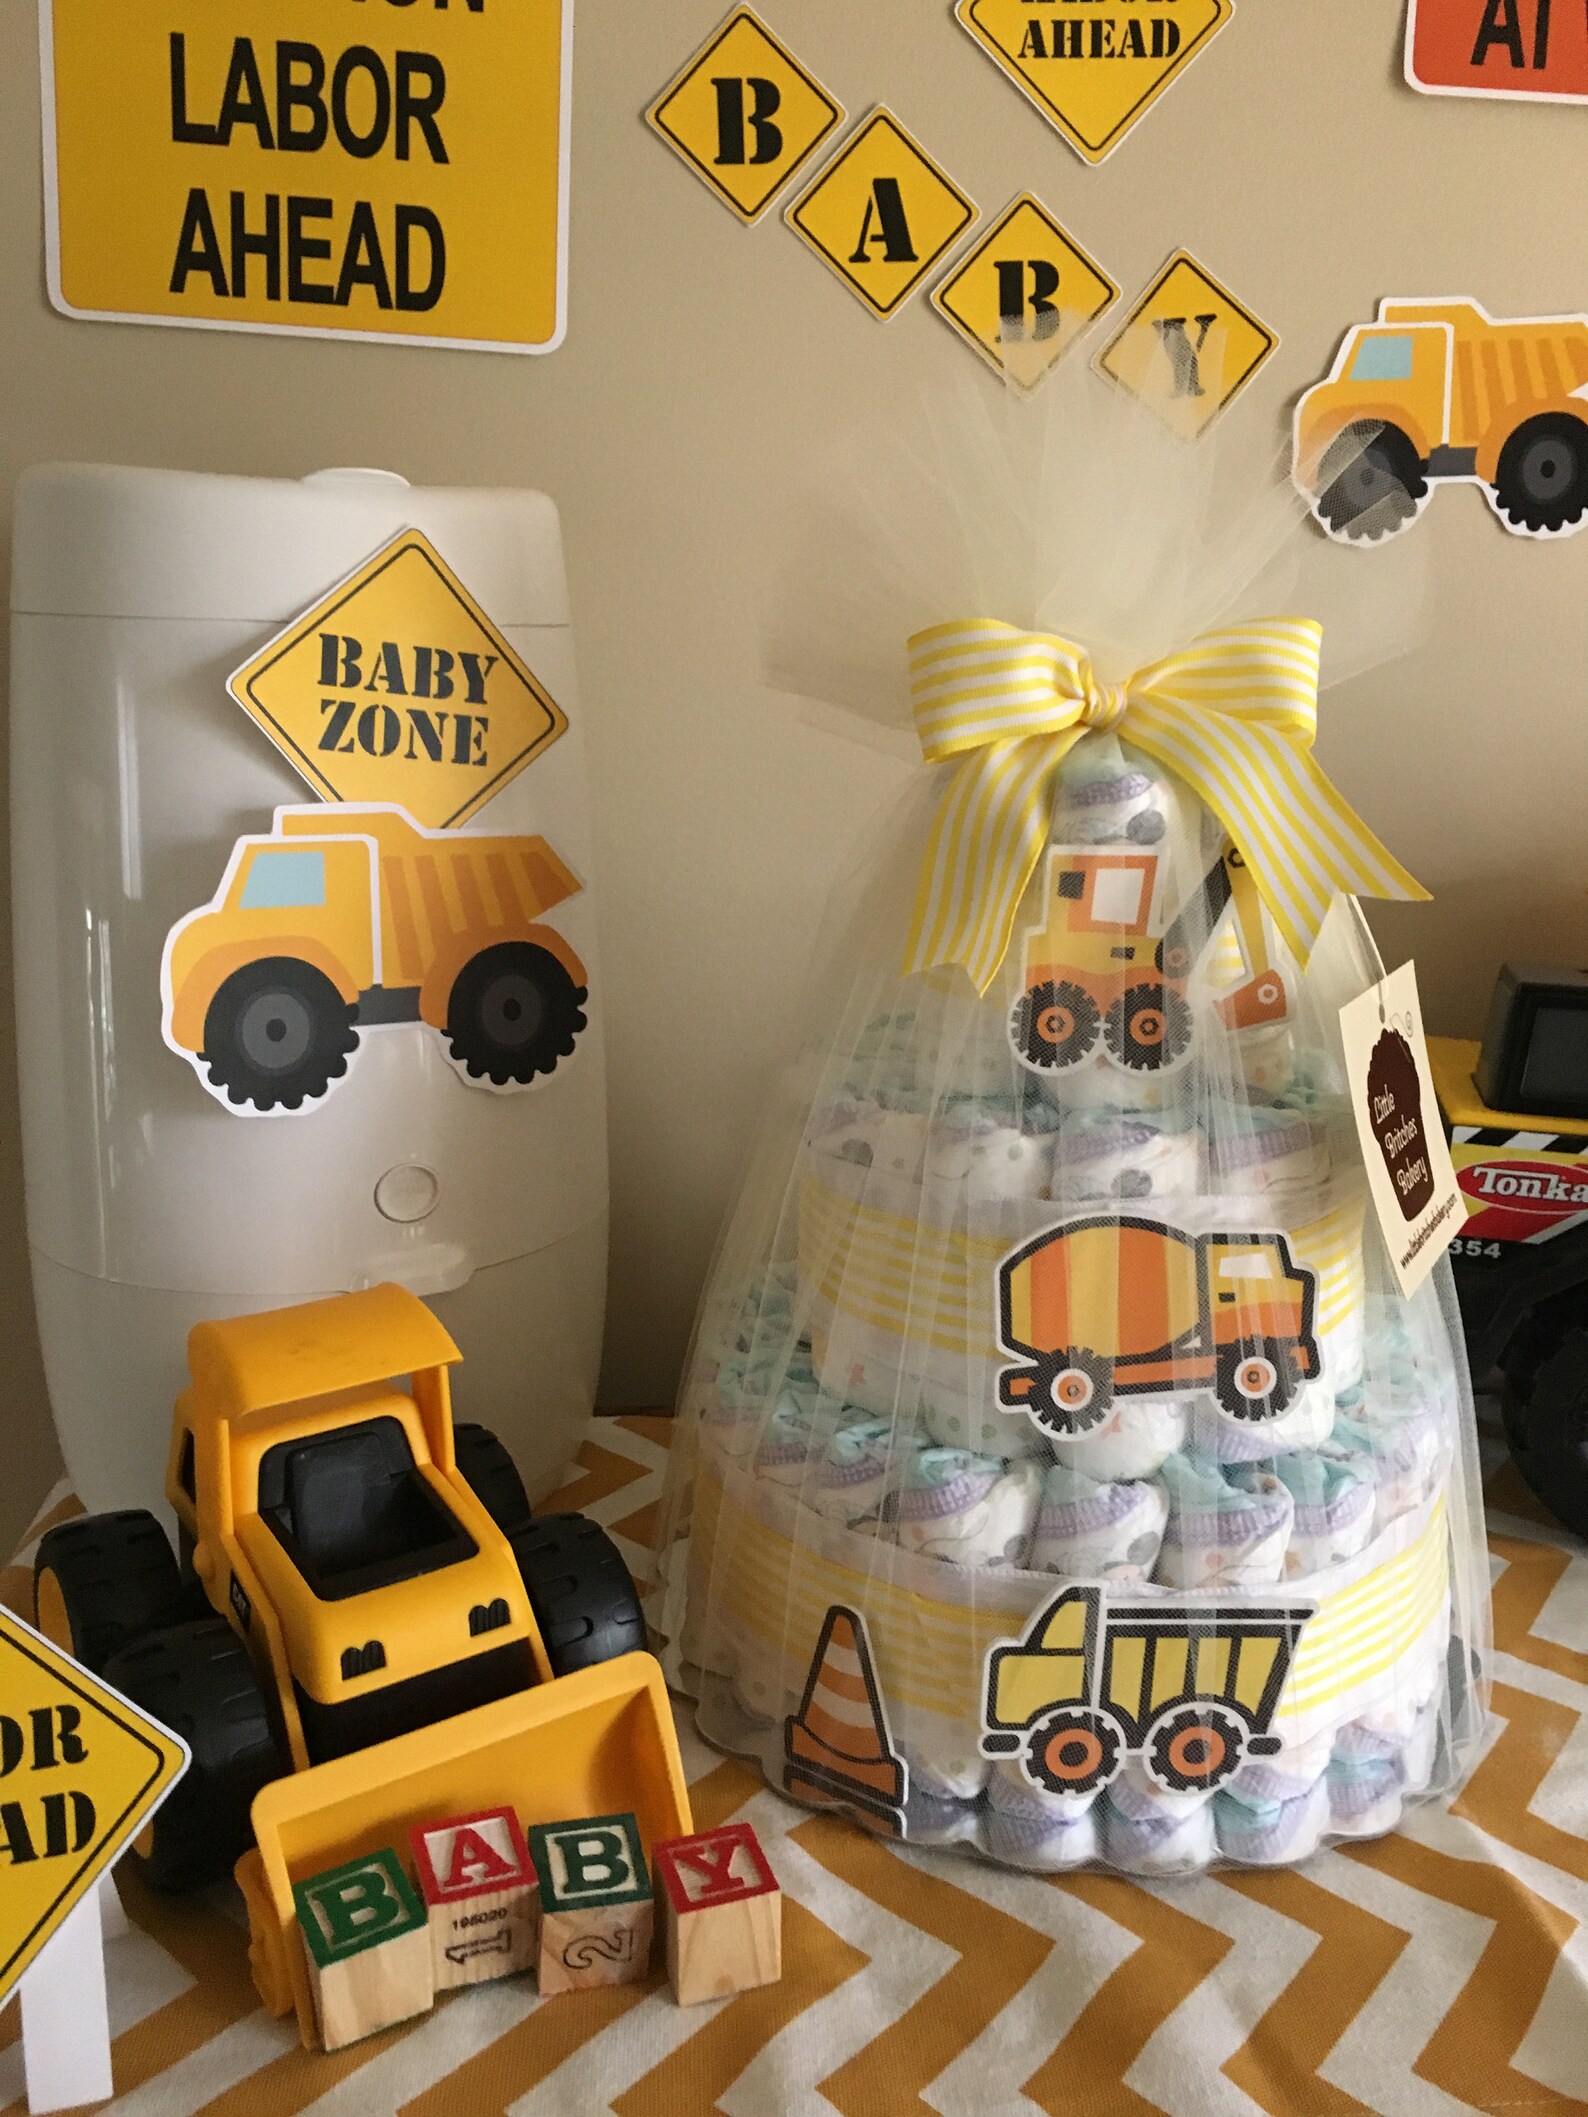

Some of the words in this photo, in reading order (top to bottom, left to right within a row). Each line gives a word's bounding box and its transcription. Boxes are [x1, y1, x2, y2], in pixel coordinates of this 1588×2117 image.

[1017, 19, 1181, 59] AHEAD
[169, 31, 450, 164] LABOR
[711, 77, 783, 165] B
[169, 187, 446, 312] AHEAD
[848, 178, 919, 263] A
[993, 260, 1061, 343] B
[1153, 313, 1218, 398] Y
[317, 632, 499, 705] BABY
[317, 698, 490, 767] ZONE
[1373, 1083, 1396, 1125] Little
[1384, 1114, 1418, 1159] Britches
[1396, 1157, 1429, 1196] Bakery
[1472, 1166, 1588, 1203] Tonka
[1448, 1238, 1502, 1259] 354
[443, 1827, 517, 1888] A
[555, 1831, 630, 1895] B
[673, 1836, 745, 1895] Y
[322, 1870, 403, 1947] B
